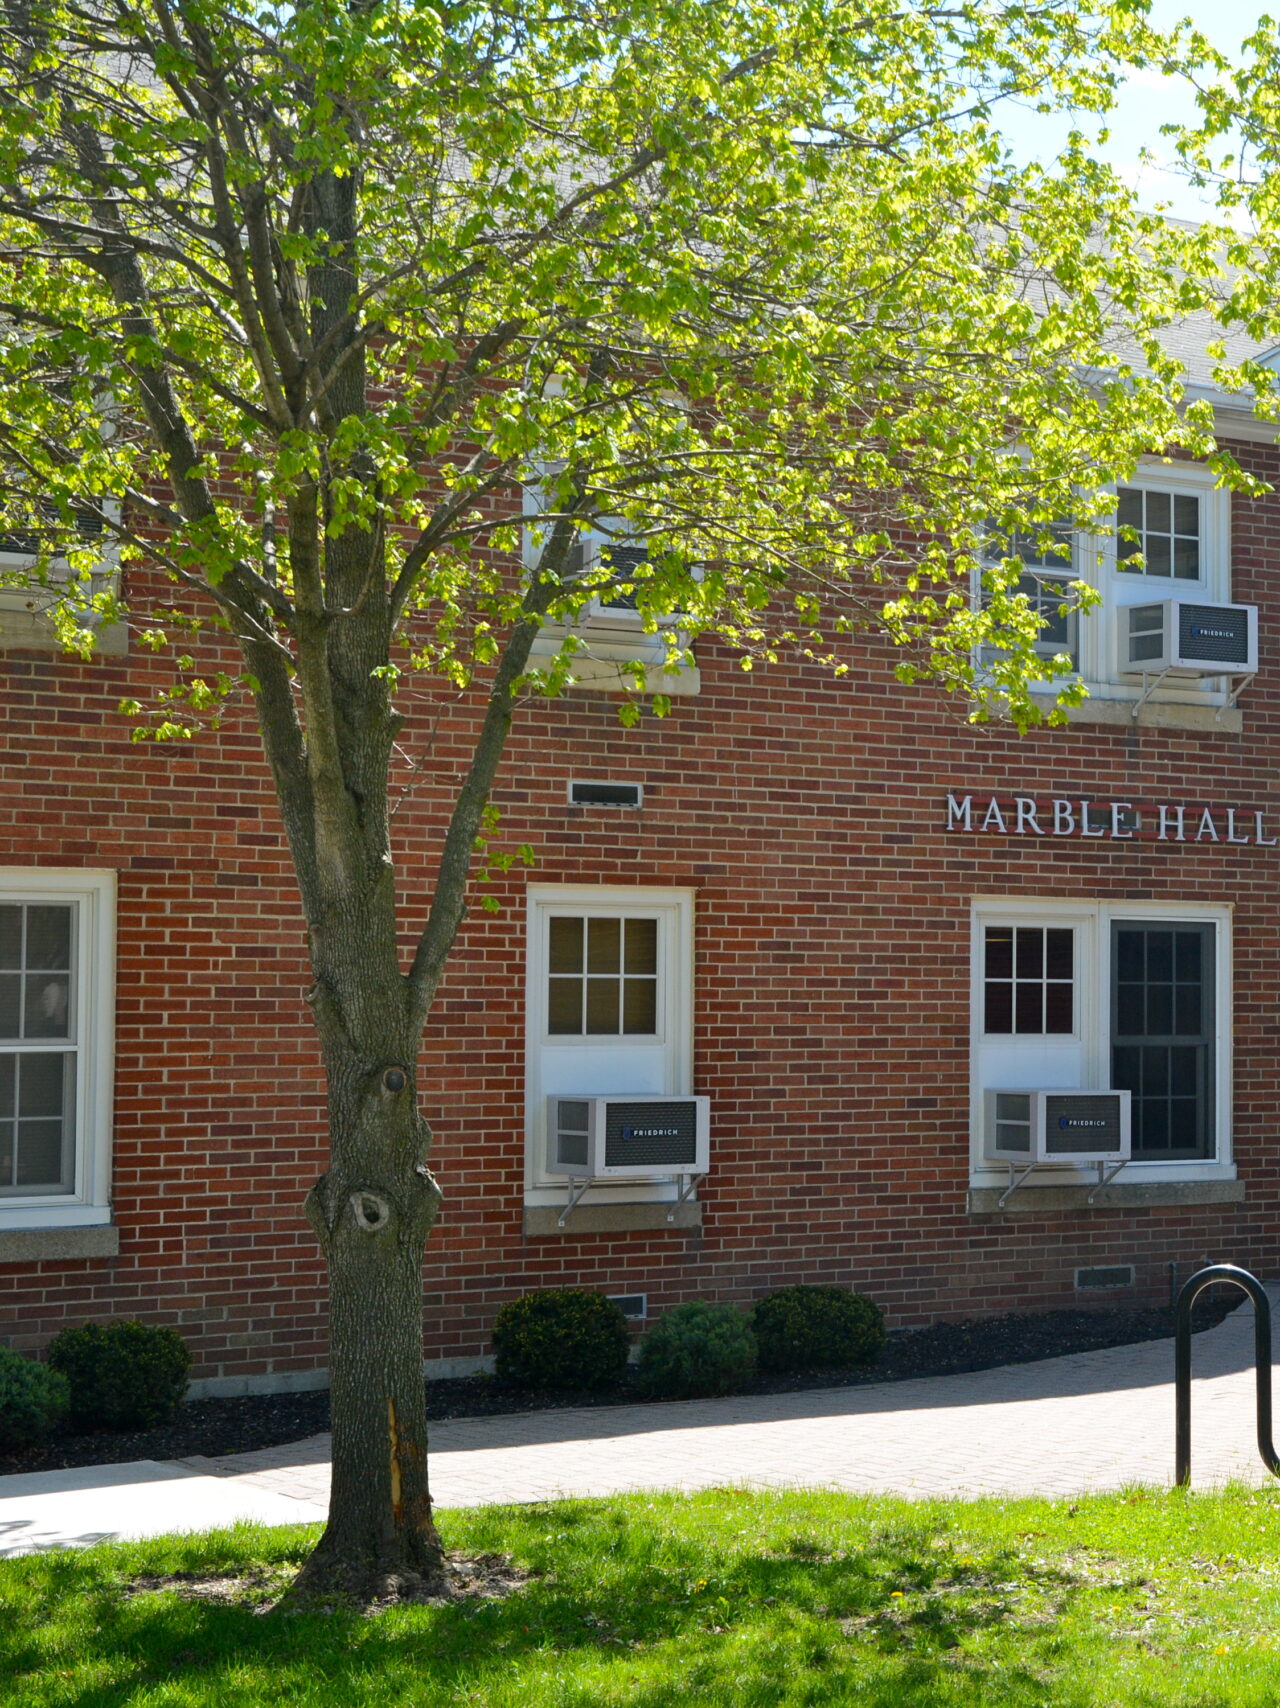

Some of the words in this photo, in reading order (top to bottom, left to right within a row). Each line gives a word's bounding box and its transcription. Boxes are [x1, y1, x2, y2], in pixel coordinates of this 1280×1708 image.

[1200, 629, 1234, 637] FRIEDRICH
[946, 794, 1133, 837] MARBLE
[1157, 805, 1278, 845] HALL
